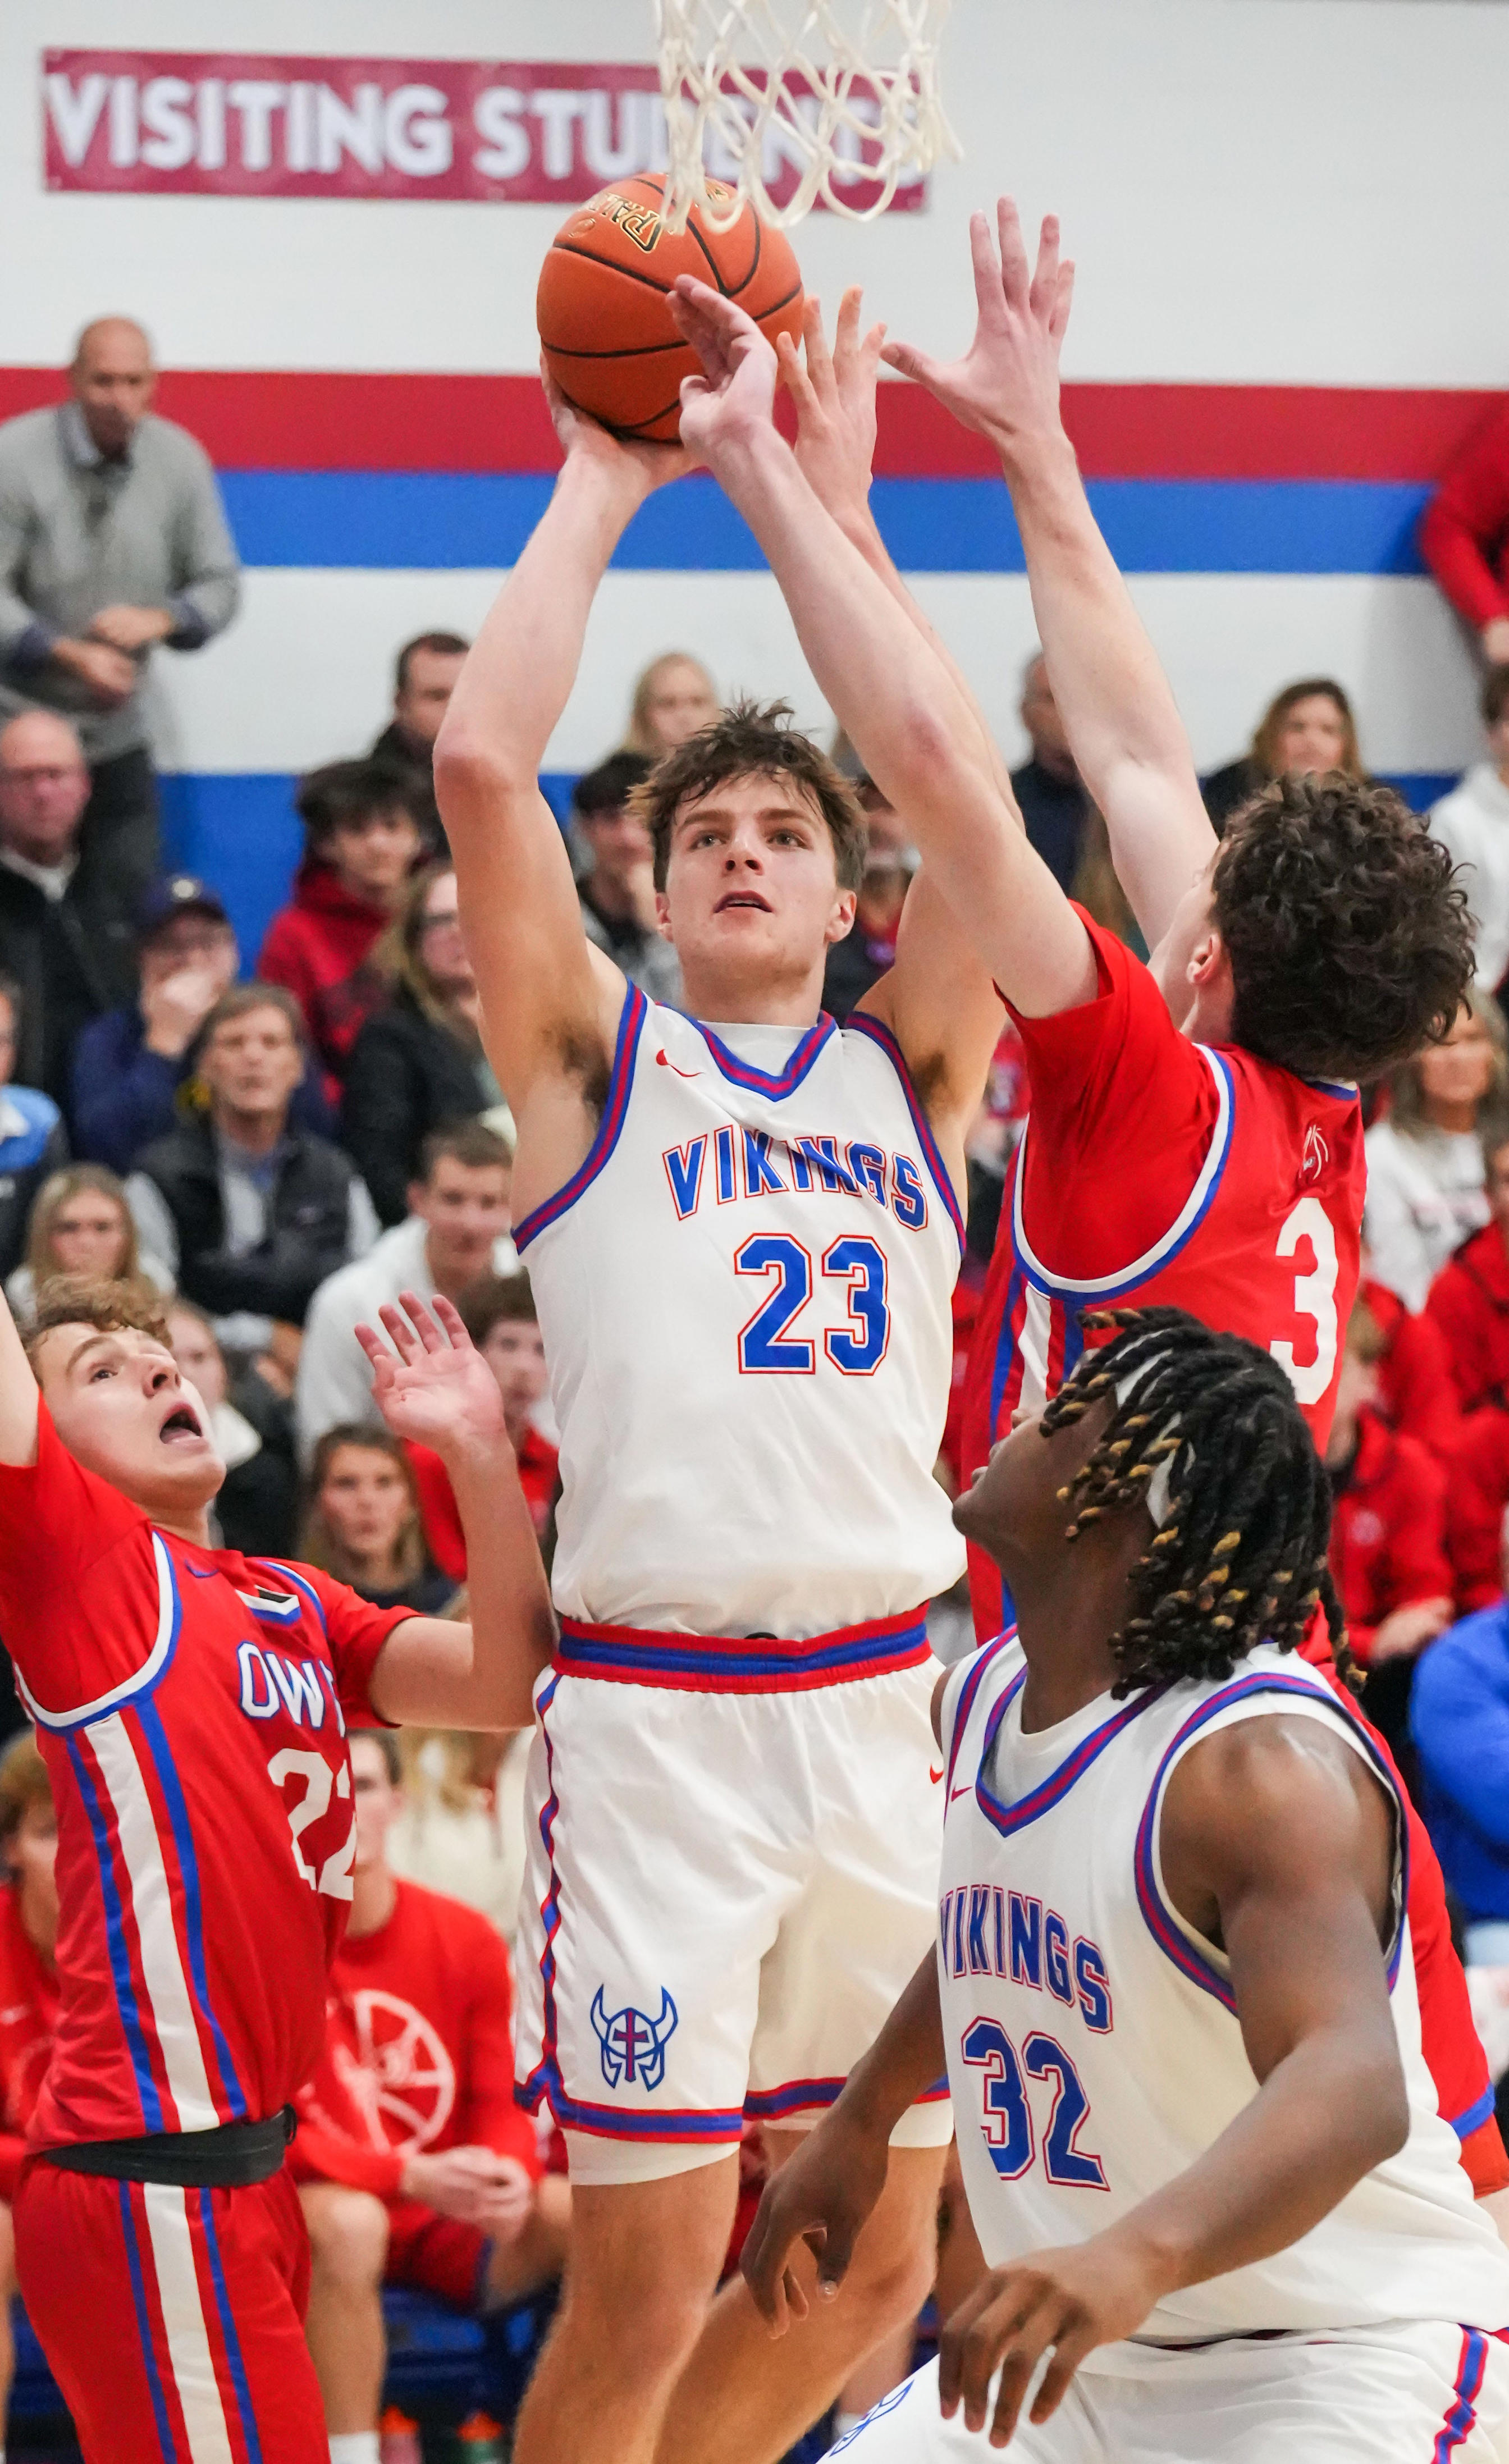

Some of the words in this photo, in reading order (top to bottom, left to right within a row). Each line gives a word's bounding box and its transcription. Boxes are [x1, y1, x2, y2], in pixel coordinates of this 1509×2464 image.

[46, 72, 453, 177] VISITING
[662, 1124, 929, 1232] VIKINGS
[733, 1232, 891, 1376] 23
[1270, 1197, 1339, 1405] 3
[236, 1640, 346, 1738] OW
[940, 1883, 1114, 2035] VIKINGS
[961, 2015, 1112, 2192] 32
